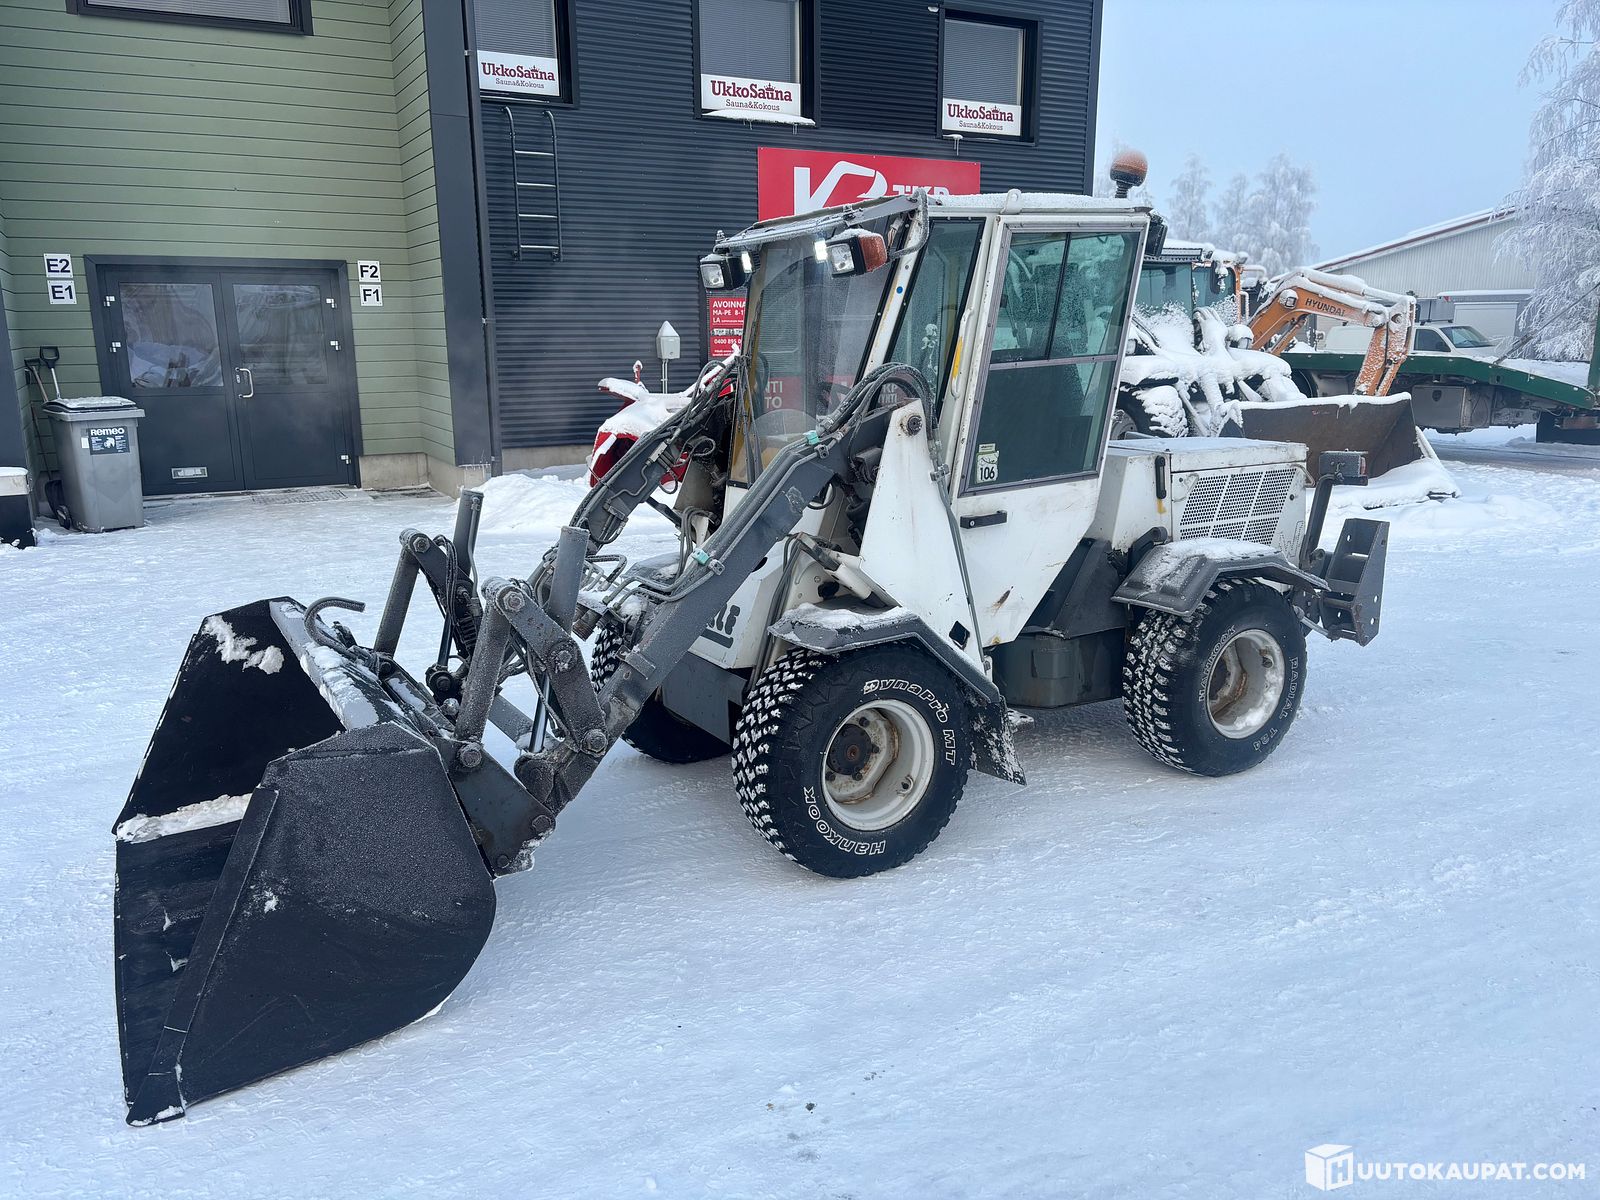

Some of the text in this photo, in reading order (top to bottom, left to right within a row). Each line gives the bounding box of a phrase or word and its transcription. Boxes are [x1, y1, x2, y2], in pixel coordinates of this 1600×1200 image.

[481, 62, 555, 81] UkkoSauna
[495, 78, 545, 89] Sauna&Kokous
[711, 80, 792, 102] UkkoSauna
[725, 99, 780, 111] Sauna&Kokous
[947, 103, 1014, 122] UkkoSauna
[958, 120, 1003, 131] Sauna&Kokous
[46, 258, 71, 273] E2
[359, 264, 379, 279] F2
[51, 284, 73, 300] E1
[362, 288, 380, 302] F1
[1305, 297, 1346, 317] HYUNDAI
[979, 467, 996, 480] 106
[1278, 657, 1299, 719] RADIAL
[942, 729, 956, 766] MT
